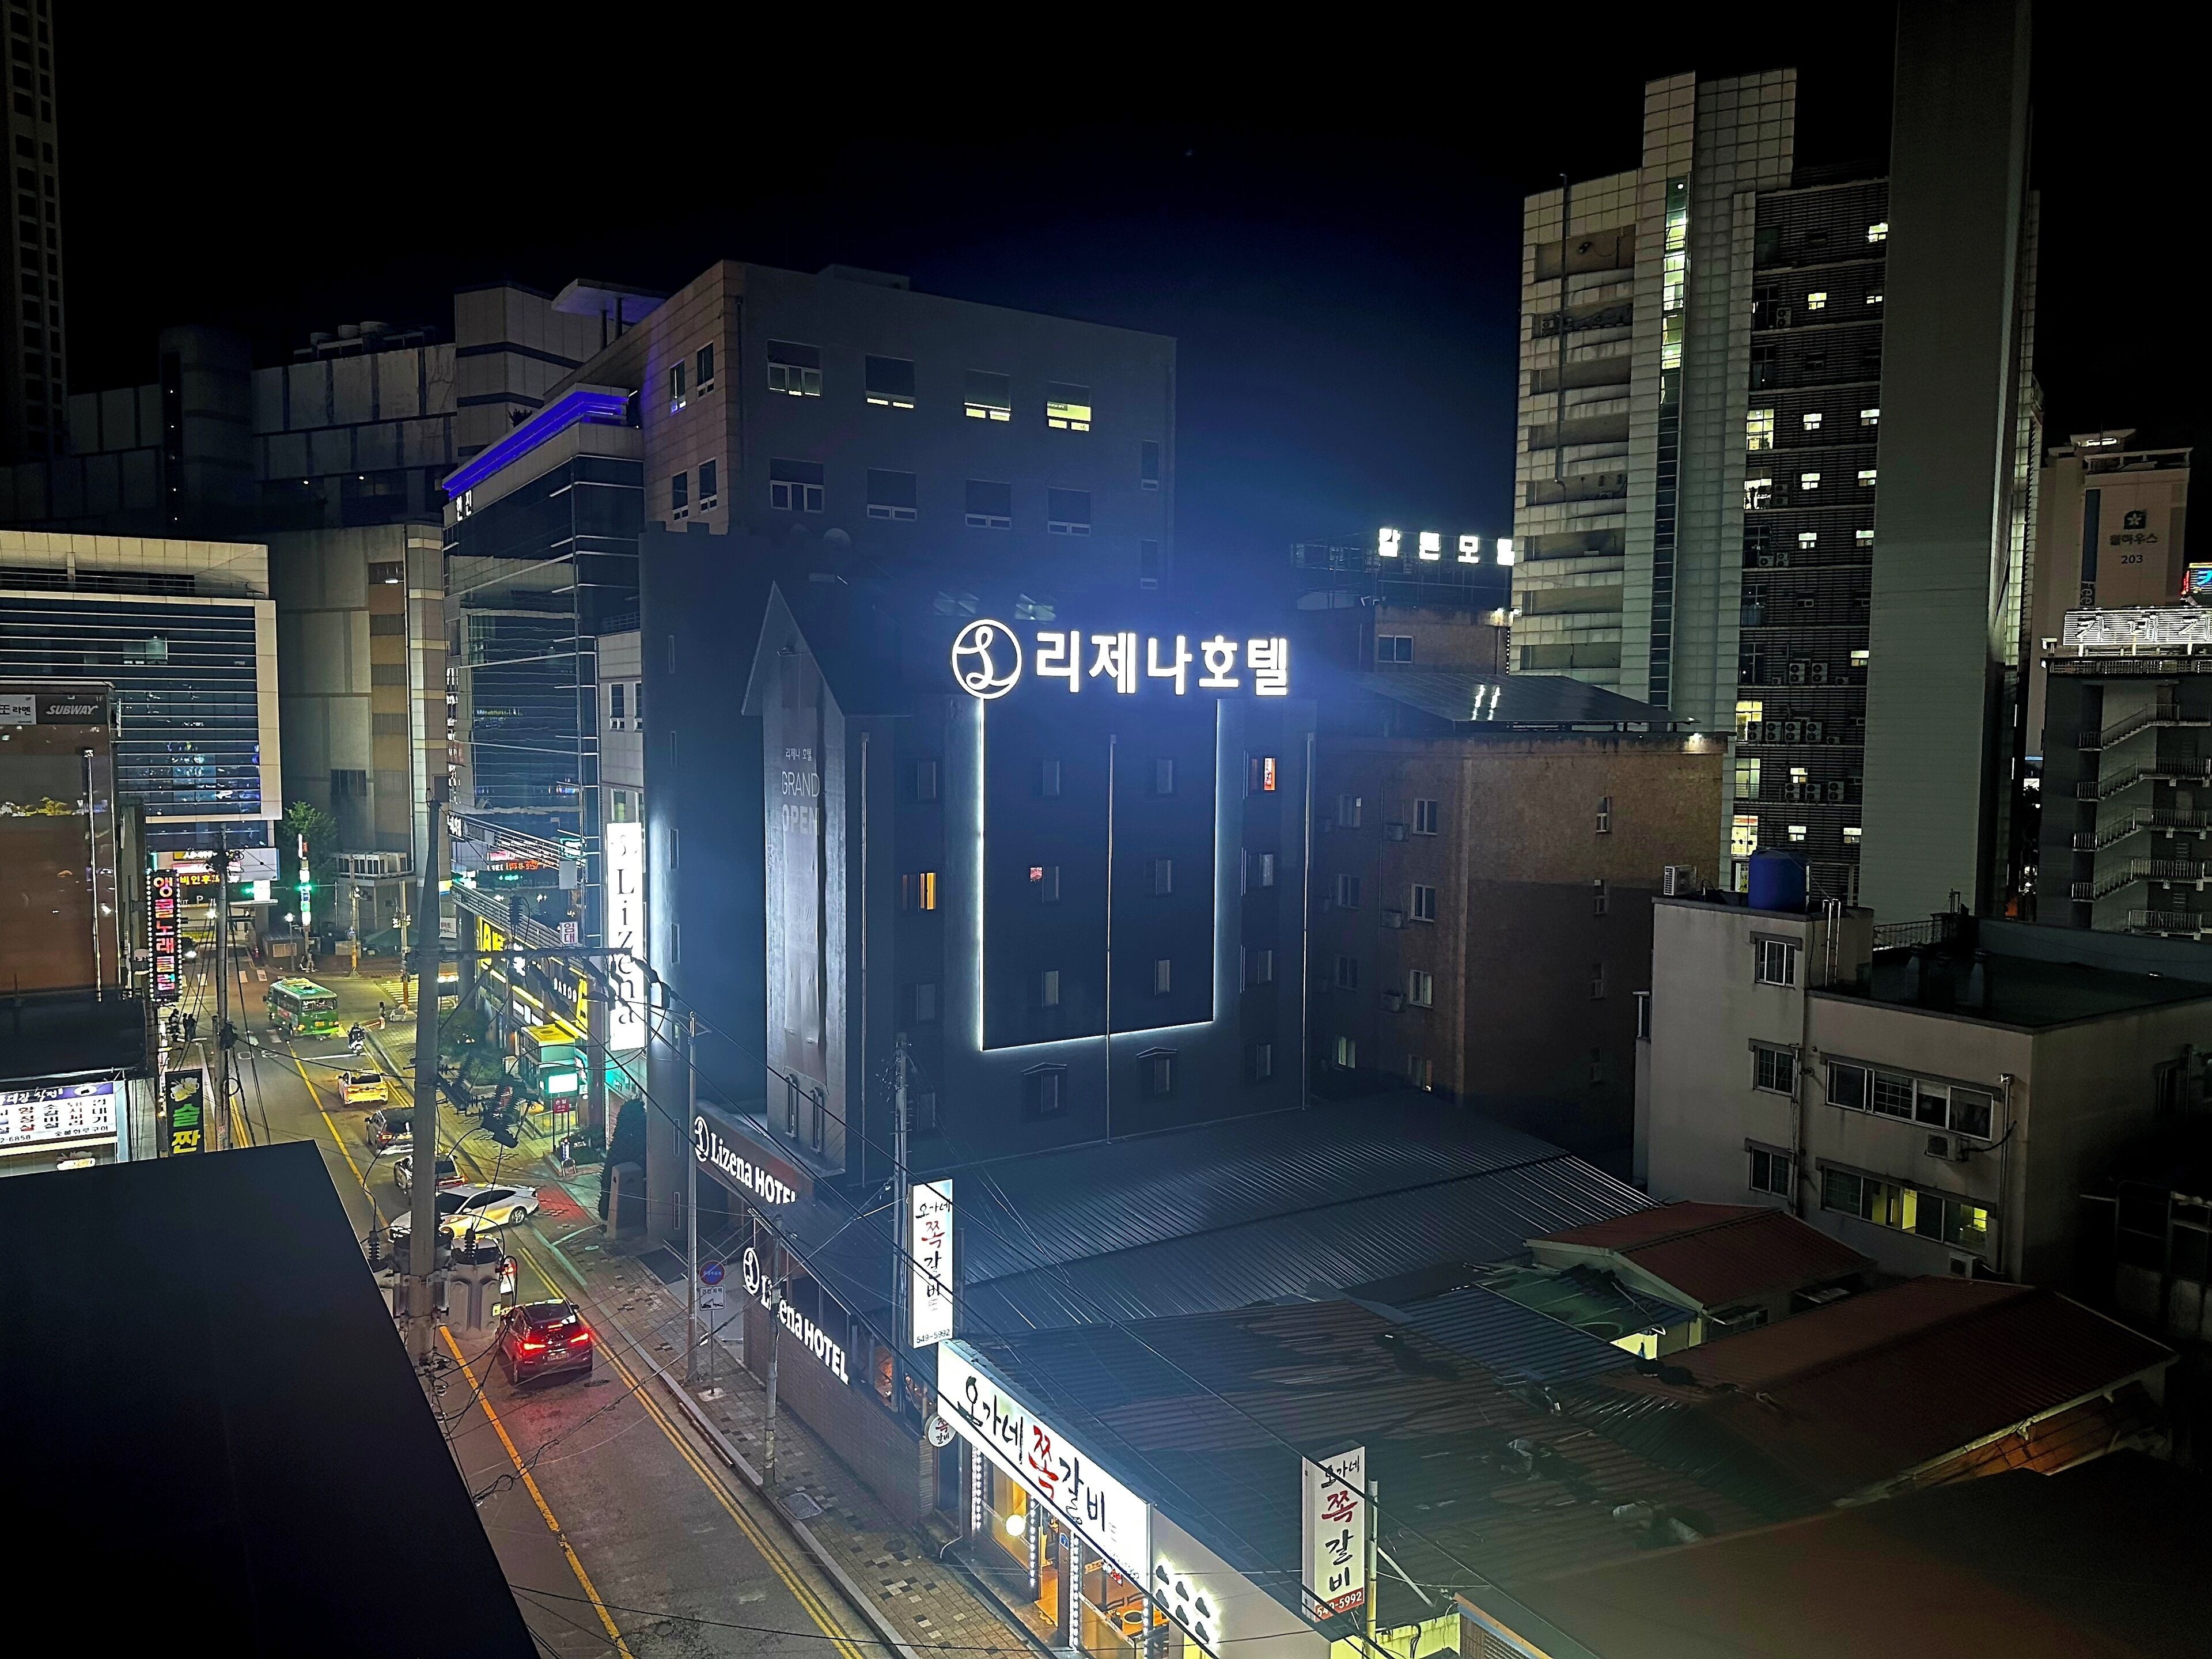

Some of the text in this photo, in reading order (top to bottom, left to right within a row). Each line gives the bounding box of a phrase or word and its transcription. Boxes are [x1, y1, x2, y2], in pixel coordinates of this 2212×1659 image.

[2122, 554, 2143, 564] 203
[1036, 630, 1287, 696] 리제나호텔
[46, 704, 99, 715] SUBWAY
[782, 771, 820, 797] GRAND
[782, 804, 819, 835] OPEN
[564, 923, 575, 943] 임대
[172, 1103, 200, 1154] 술짠
[711, 1132, 753, 1188] Lizena
[921, 1220, 945, 1297] 쪽갈비
[761, 1275, 849, 1385] Liena HOTEL
[916, 1329, 950, 1343] 549-5992
[1028, 1425, 1106, 1532] 쪽갈비
[1321, 1455, 1360, 1488] 오가네
[1321, 1490, 1358, 1592] 쪽갈비
